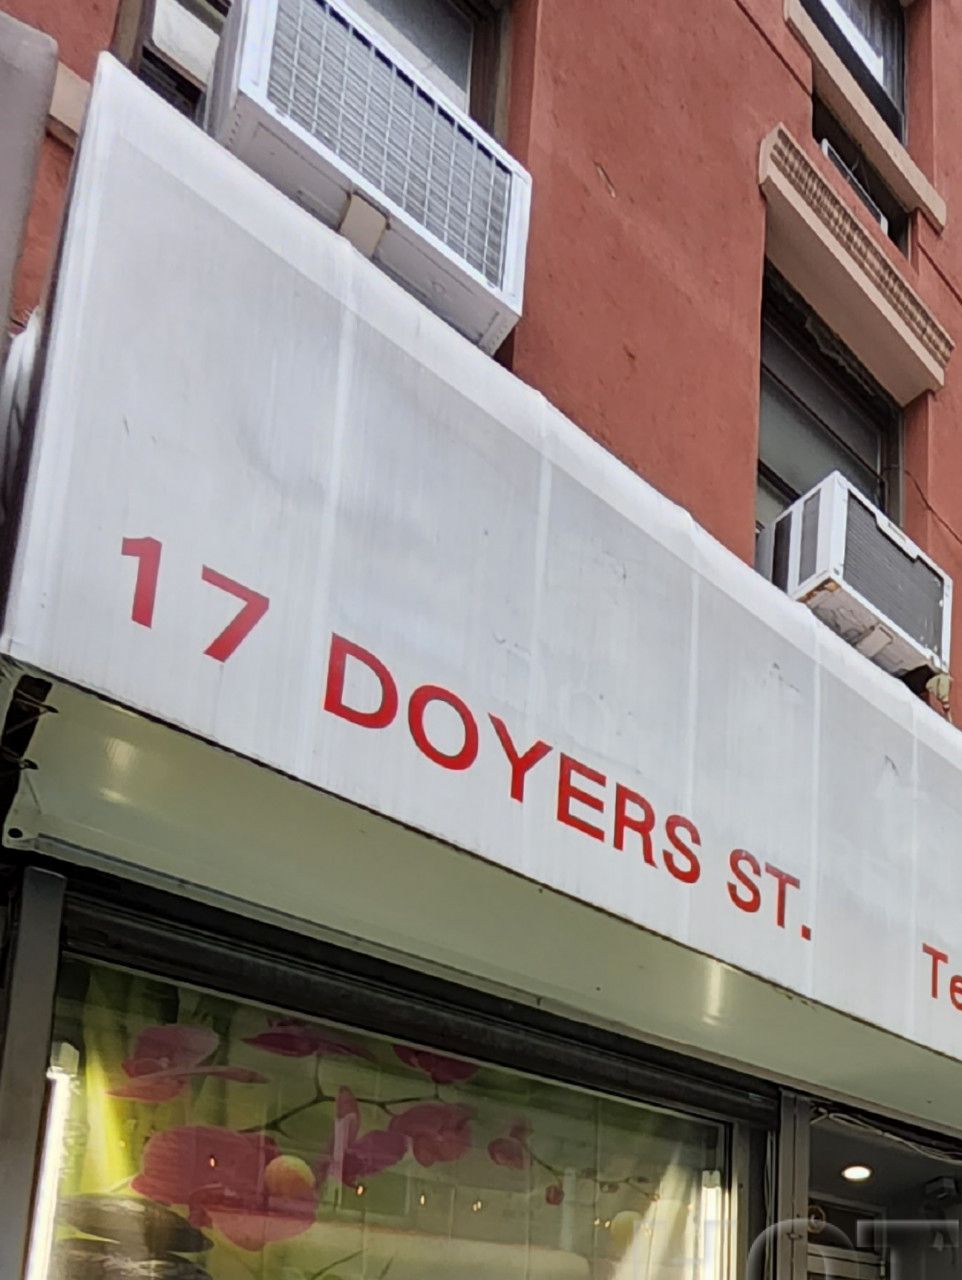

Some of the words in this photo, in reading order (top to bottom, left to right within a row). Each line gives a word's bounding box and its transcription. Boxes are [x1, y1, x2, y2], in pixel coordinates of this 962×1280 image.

[121, 536, 270, 662] 17
[323, 632, 702, 884] DOYERS
[726, 847, 813, 941] ST.
